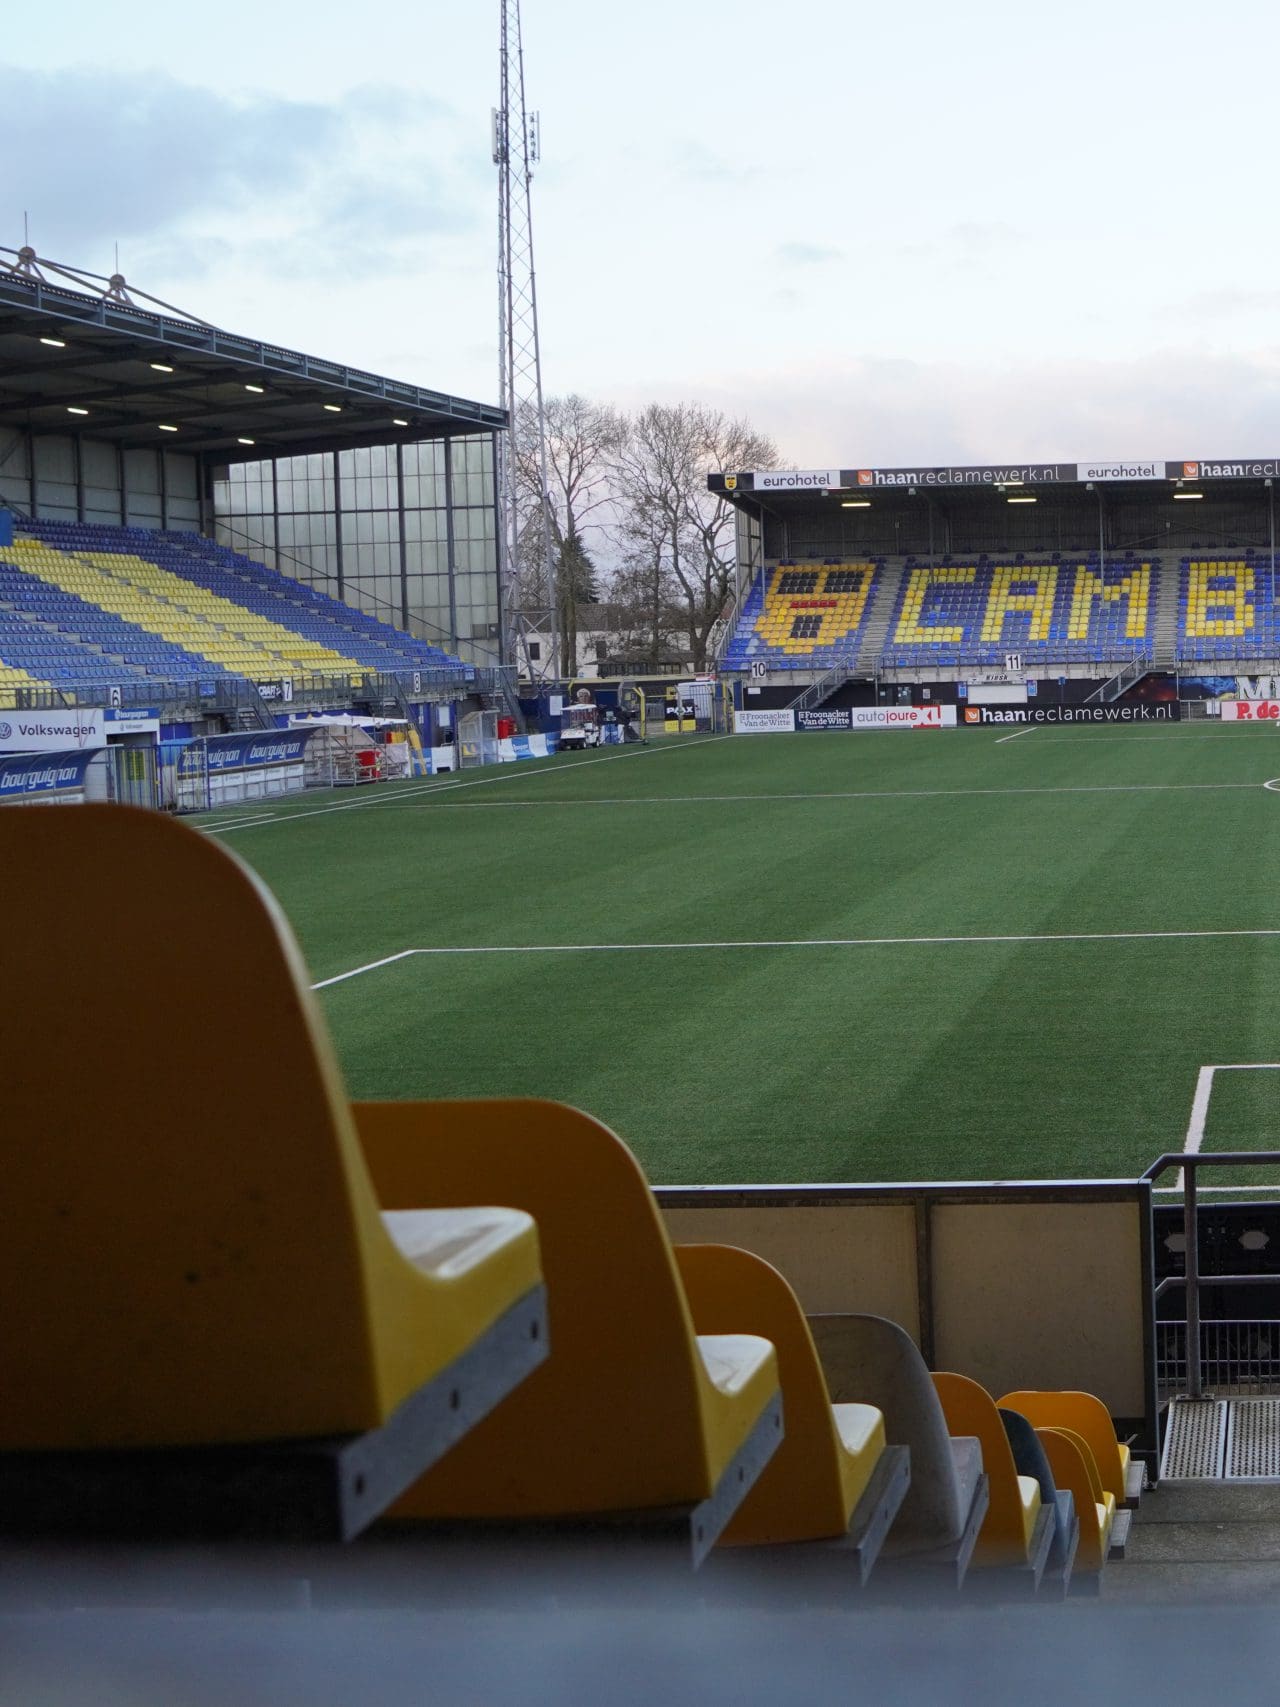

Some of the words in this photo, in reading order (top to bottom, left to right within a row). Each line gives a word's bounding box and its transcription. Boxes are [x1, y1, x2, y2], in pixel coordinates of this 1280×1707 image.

[875, 464, 1060, 485] haanreclamewerk.nl
[1088, 464, 1156, 478] eurohotel
[763, 472, 831, 487] eurohotel
[752, 662, 766, 677] 10
[1008, 656, 1021, 670] 11
[284, 681, 291, 698] 7
[857, 710, 918, 724] autojoure
[982, 704, 1173, 722] haanreclamewerk.nl
[1236, 702, 1253, 719] P.
[1256, 701, 1279, 718] de
[18, 724, 96, 738] Volkswagen
[1, 767, 78, 790] bourguignon
